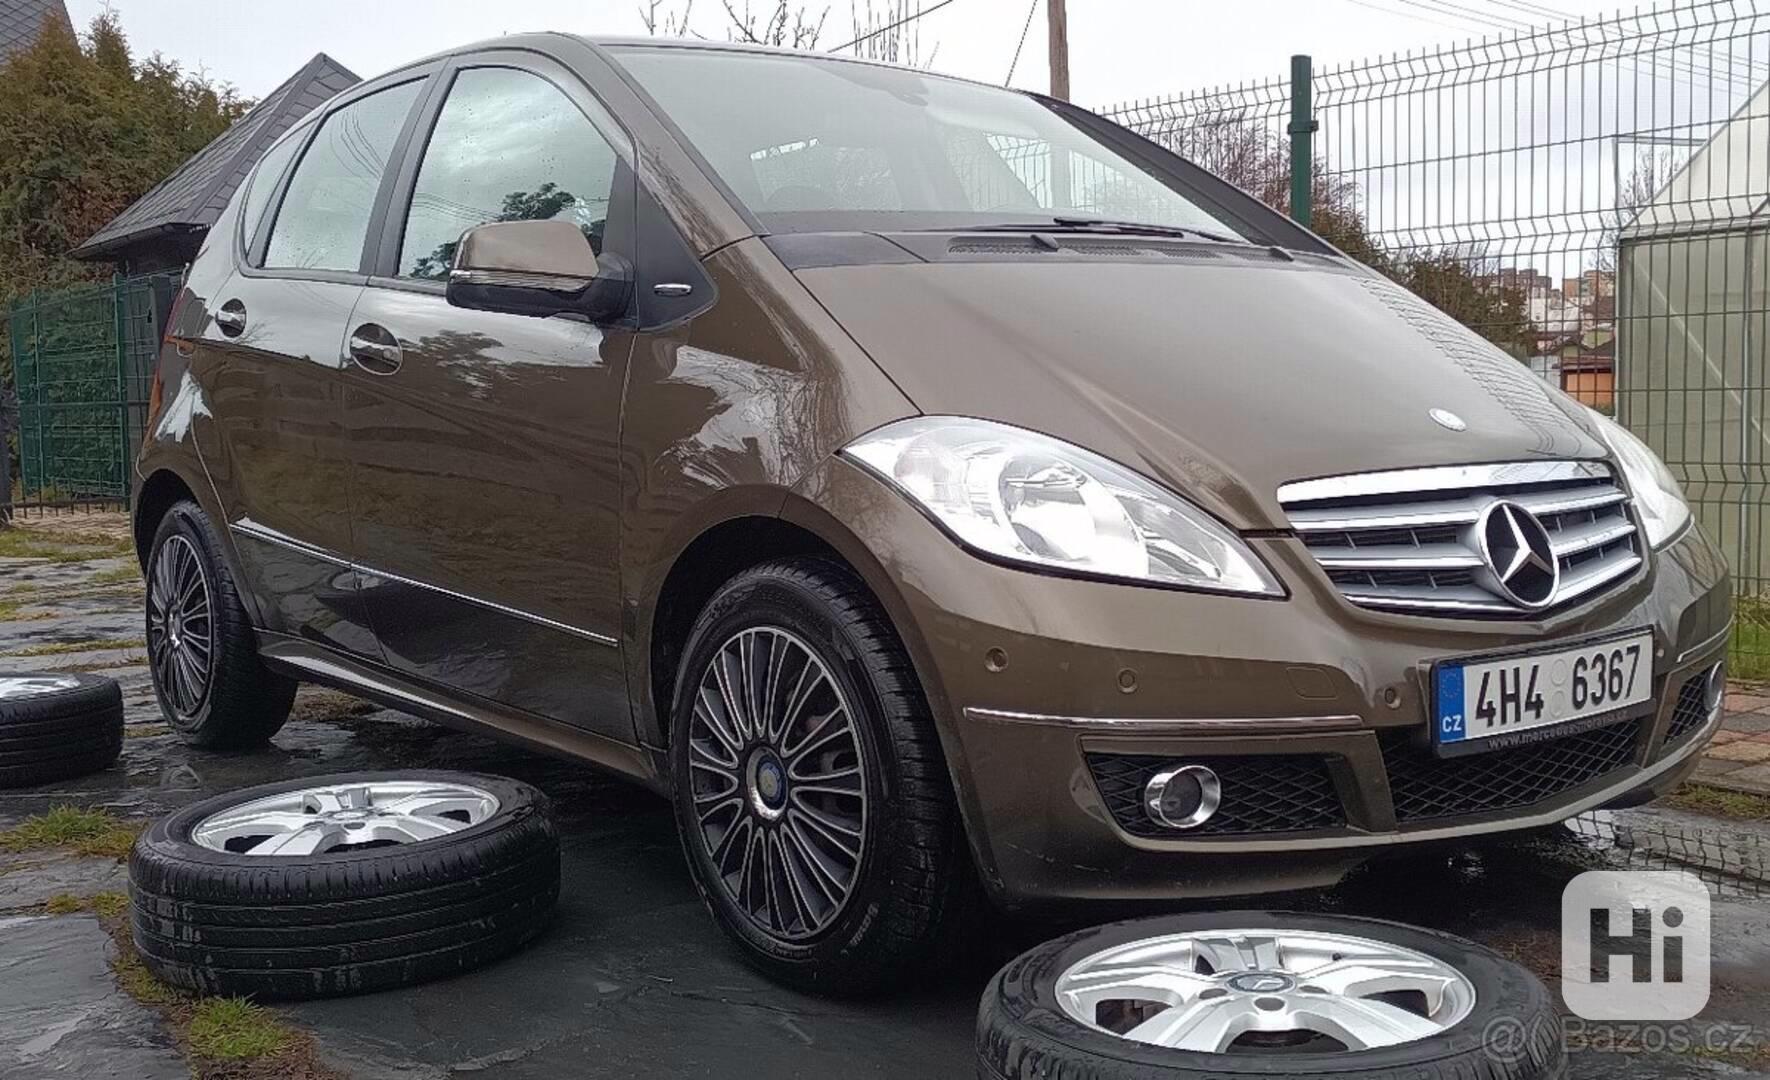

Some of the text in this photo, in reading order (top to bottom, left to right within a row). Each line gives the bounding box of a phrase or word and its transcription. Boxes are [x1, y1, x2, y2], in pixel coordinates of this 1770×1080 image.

[1475, 644, 1641, 728] 4H4 6367
[1442, 715, 1462, 732] CZ
